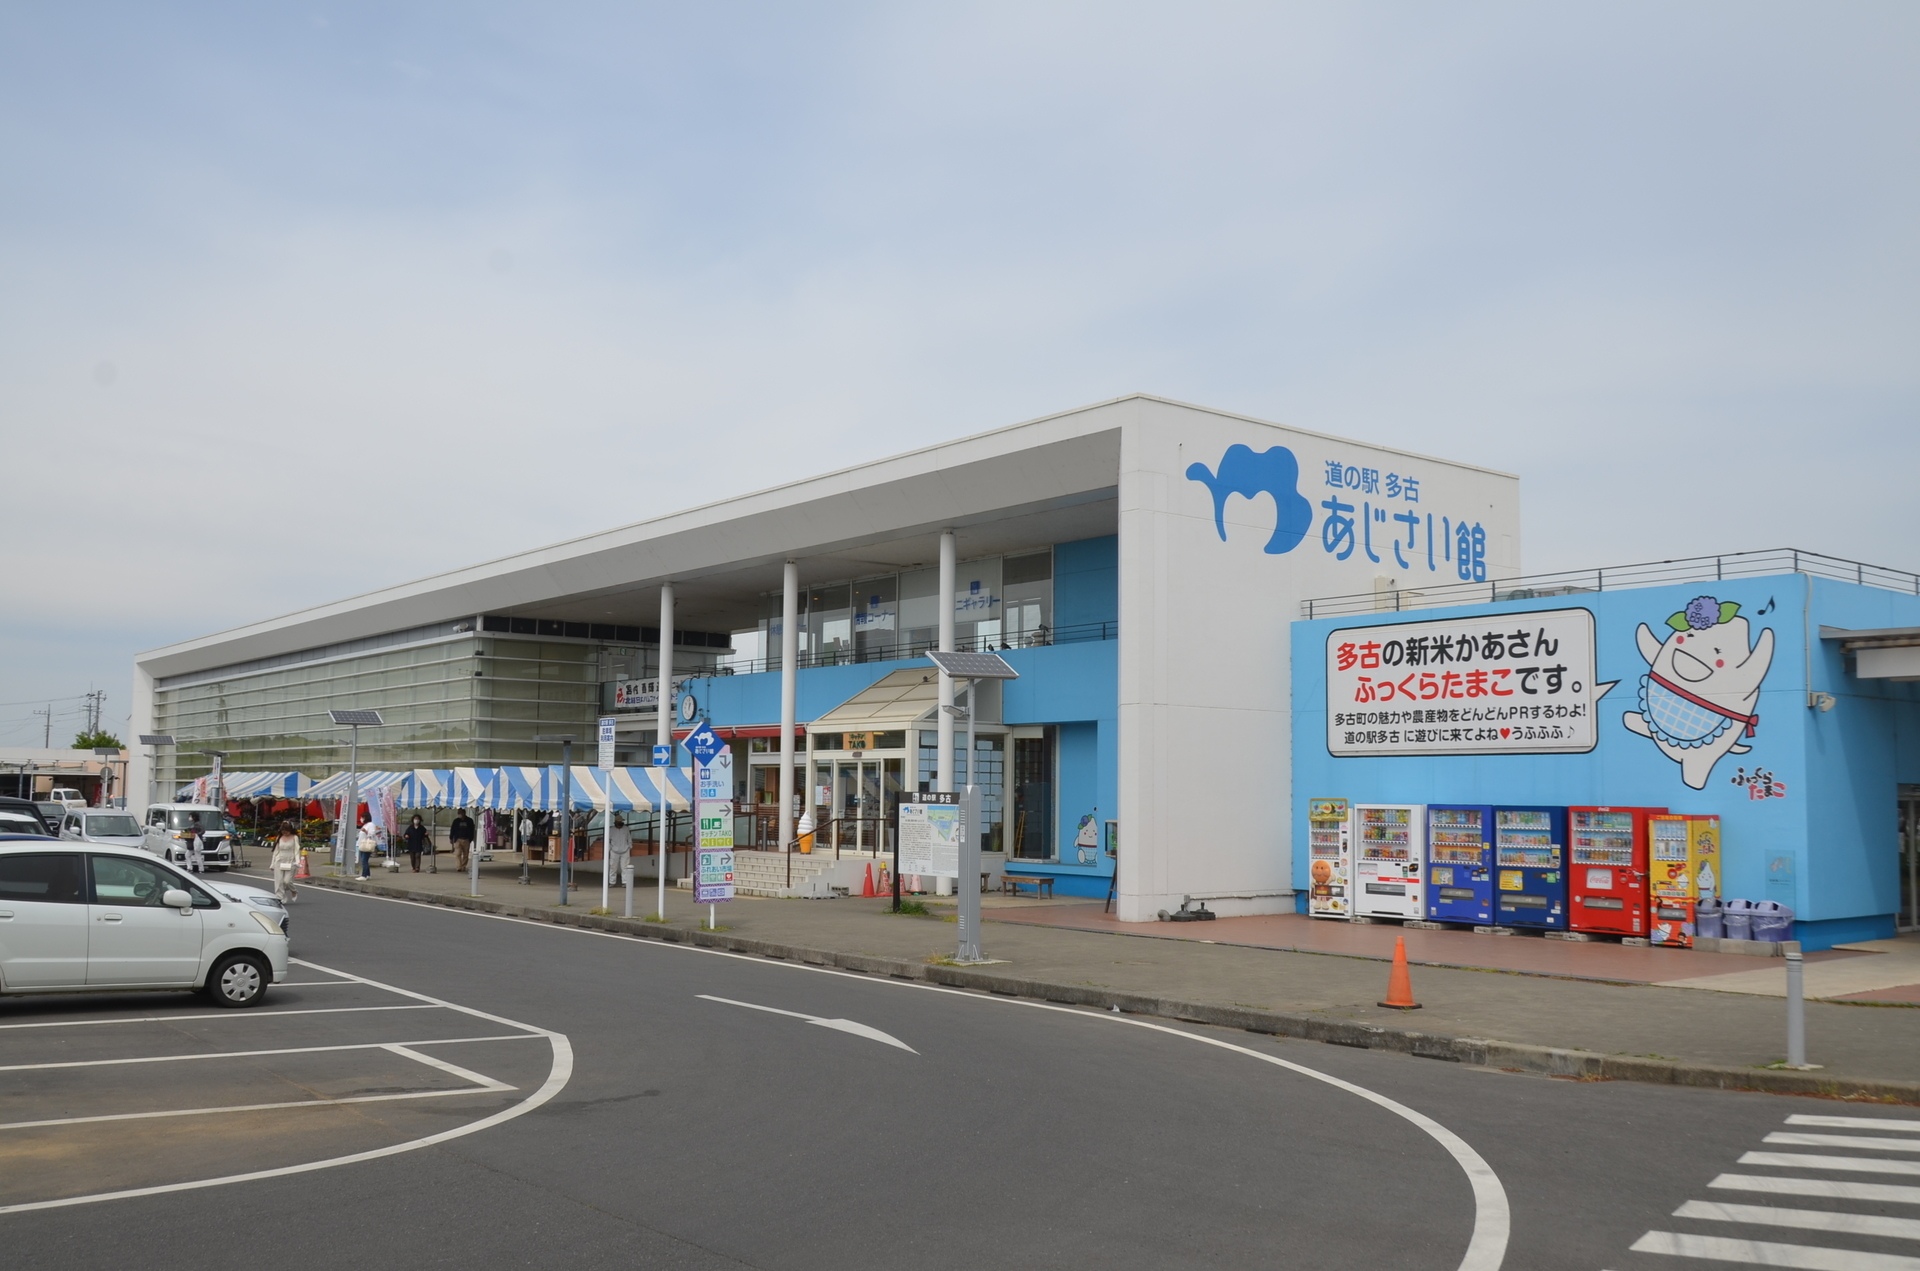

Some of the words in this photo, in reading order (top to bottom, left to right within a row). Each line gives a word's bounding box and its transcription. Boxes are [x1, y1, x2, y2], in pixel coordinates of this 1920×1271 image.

[1325, 460, 1380, 495] 道の駅
[1385, 472, 1420, 503] 多古
[1321, 494, 1487, 583] あじさい館
[1336, 627, 1559, 672] 多古の新米かあさん
[1355, 664, 1583, 703] ふっくらたまこです。
[848, 740, 866, 749] TAKO
[1731, 766, 1772, 786] ふっくら
[939, 794, 952, 803] 多古
[1748, 783, 1785, 800] たまこ
[701, 865, 732, 873] ふれあい市場
